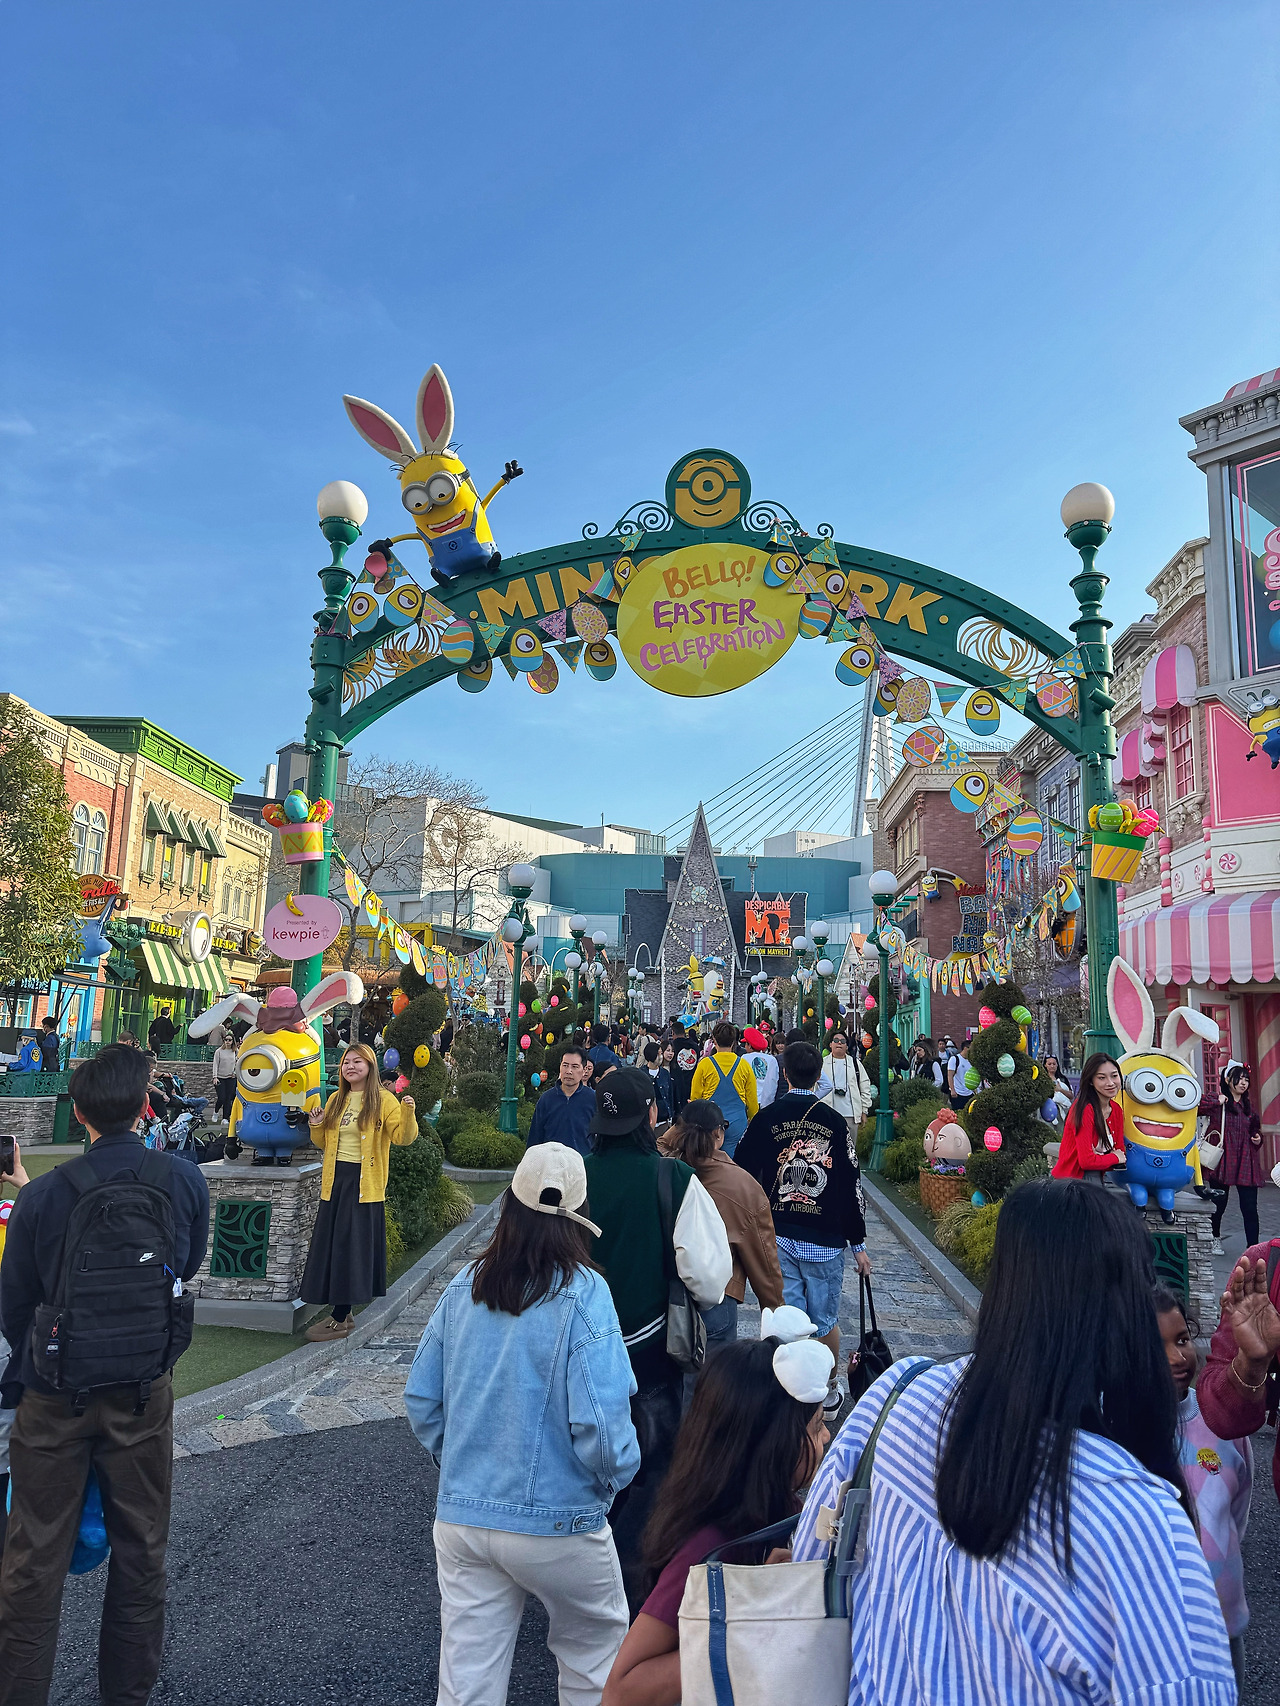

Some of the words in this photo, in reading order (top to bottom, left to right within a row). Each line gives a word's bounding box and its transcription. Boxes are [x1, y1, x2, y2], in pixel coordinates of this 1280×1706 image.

[662, 555, 756, 599] BELLO!
[477, 561, 606, 626] MIN
[812, 563, 943, 635] RK
[653, 598, 760, 633] EASTER
[639, 618, 786, 672] CELEBRATION
[745, 900, 790, 910] DESPICABLE
[272, 926, 320, 943] kewpie
